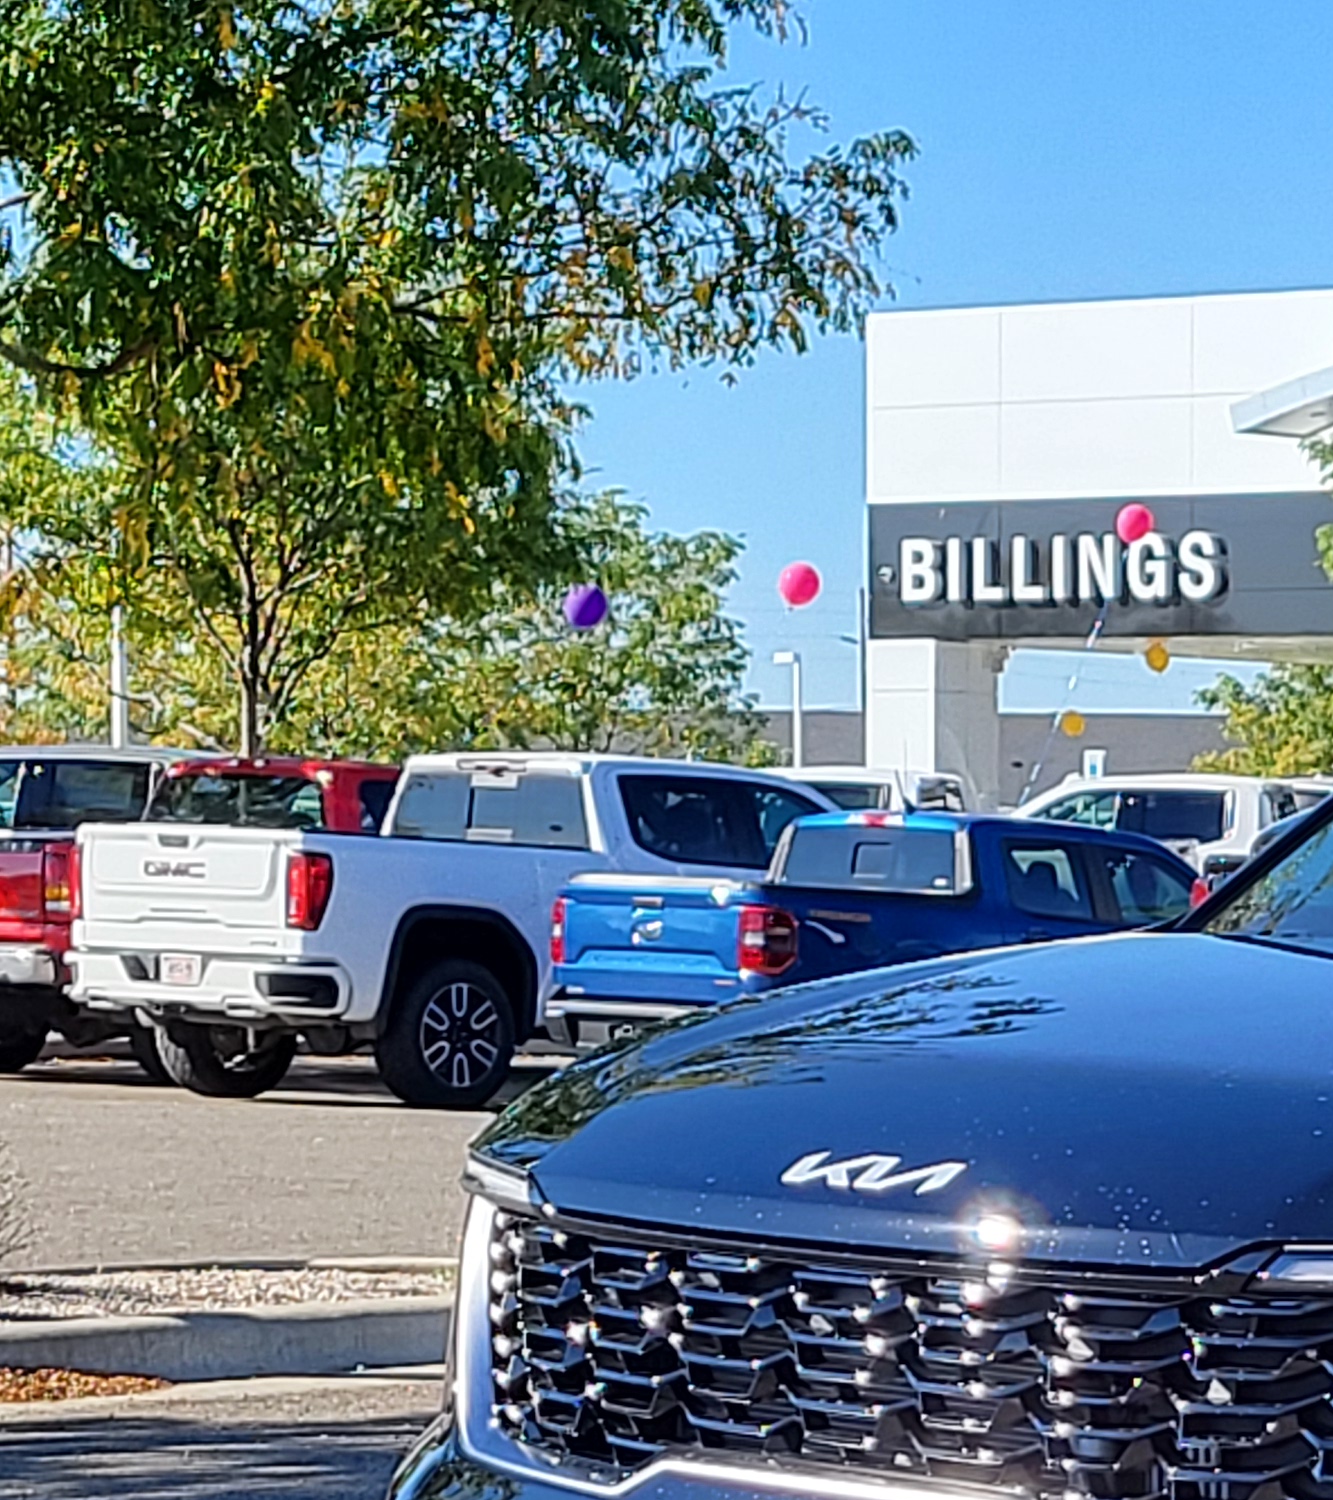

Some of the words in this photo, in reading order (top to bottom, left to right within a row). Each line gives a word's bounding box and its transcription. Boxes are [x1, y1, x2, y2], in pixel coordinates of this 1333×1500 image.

[900, 530, 1222, 604] BILLINGS
[143, 860, 206, 879] GMC
[780, 1151, 968, 1196] KIA
